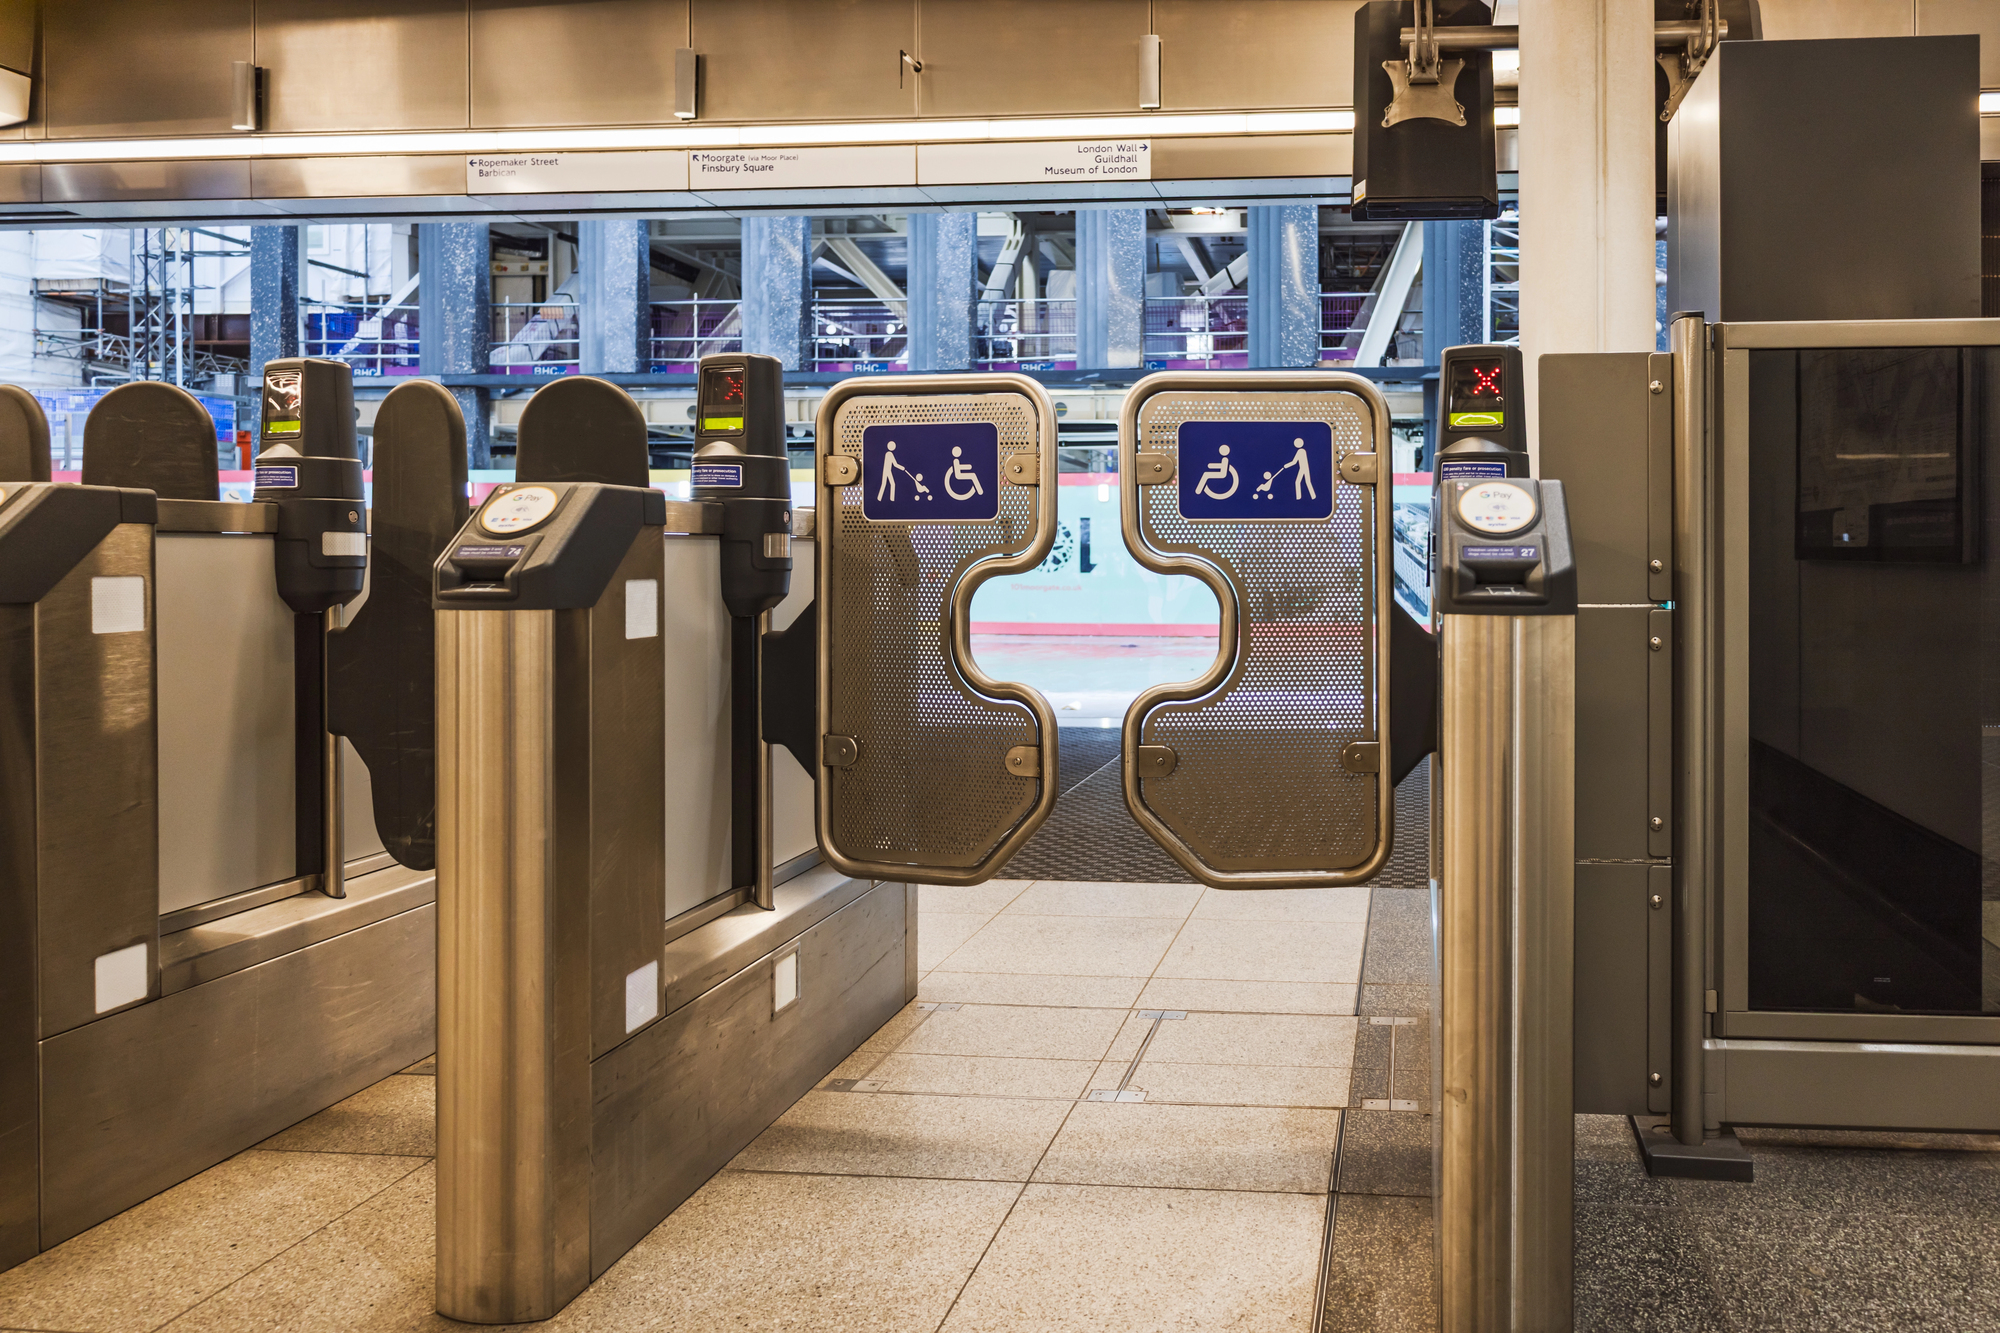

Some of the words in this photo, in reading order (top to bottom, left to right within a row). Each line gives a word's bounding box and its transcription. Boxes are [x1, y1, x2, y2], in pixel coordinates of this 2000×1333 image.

[1077, 145, 1113, 153] London
[1116, 144, 1137, 152] Wall
[478, 158, 528, 168] Ropemaker
[531, 157, 559, 166] Street
[702, 154, 745, 163] Moorgate
[1094, 154, 1138, 163] Guildhall
[478, 169, 516, 177] Barbican
[702, 164, 740, 174] Finsbury
[744, 163, 774, 173] Square
[1045, 166, 1085, 175] Museum
[1088, 166, 1099, 174] of
[1103, 165, 1138, 173] London
[534, 366, 559, 375] BHC
[524, 494, 543, 502] Pay
[1493, 491, 1512, 499] Pay
[508, 547, 522, 556] 74
[1520, 548, 1535, 556] 27
